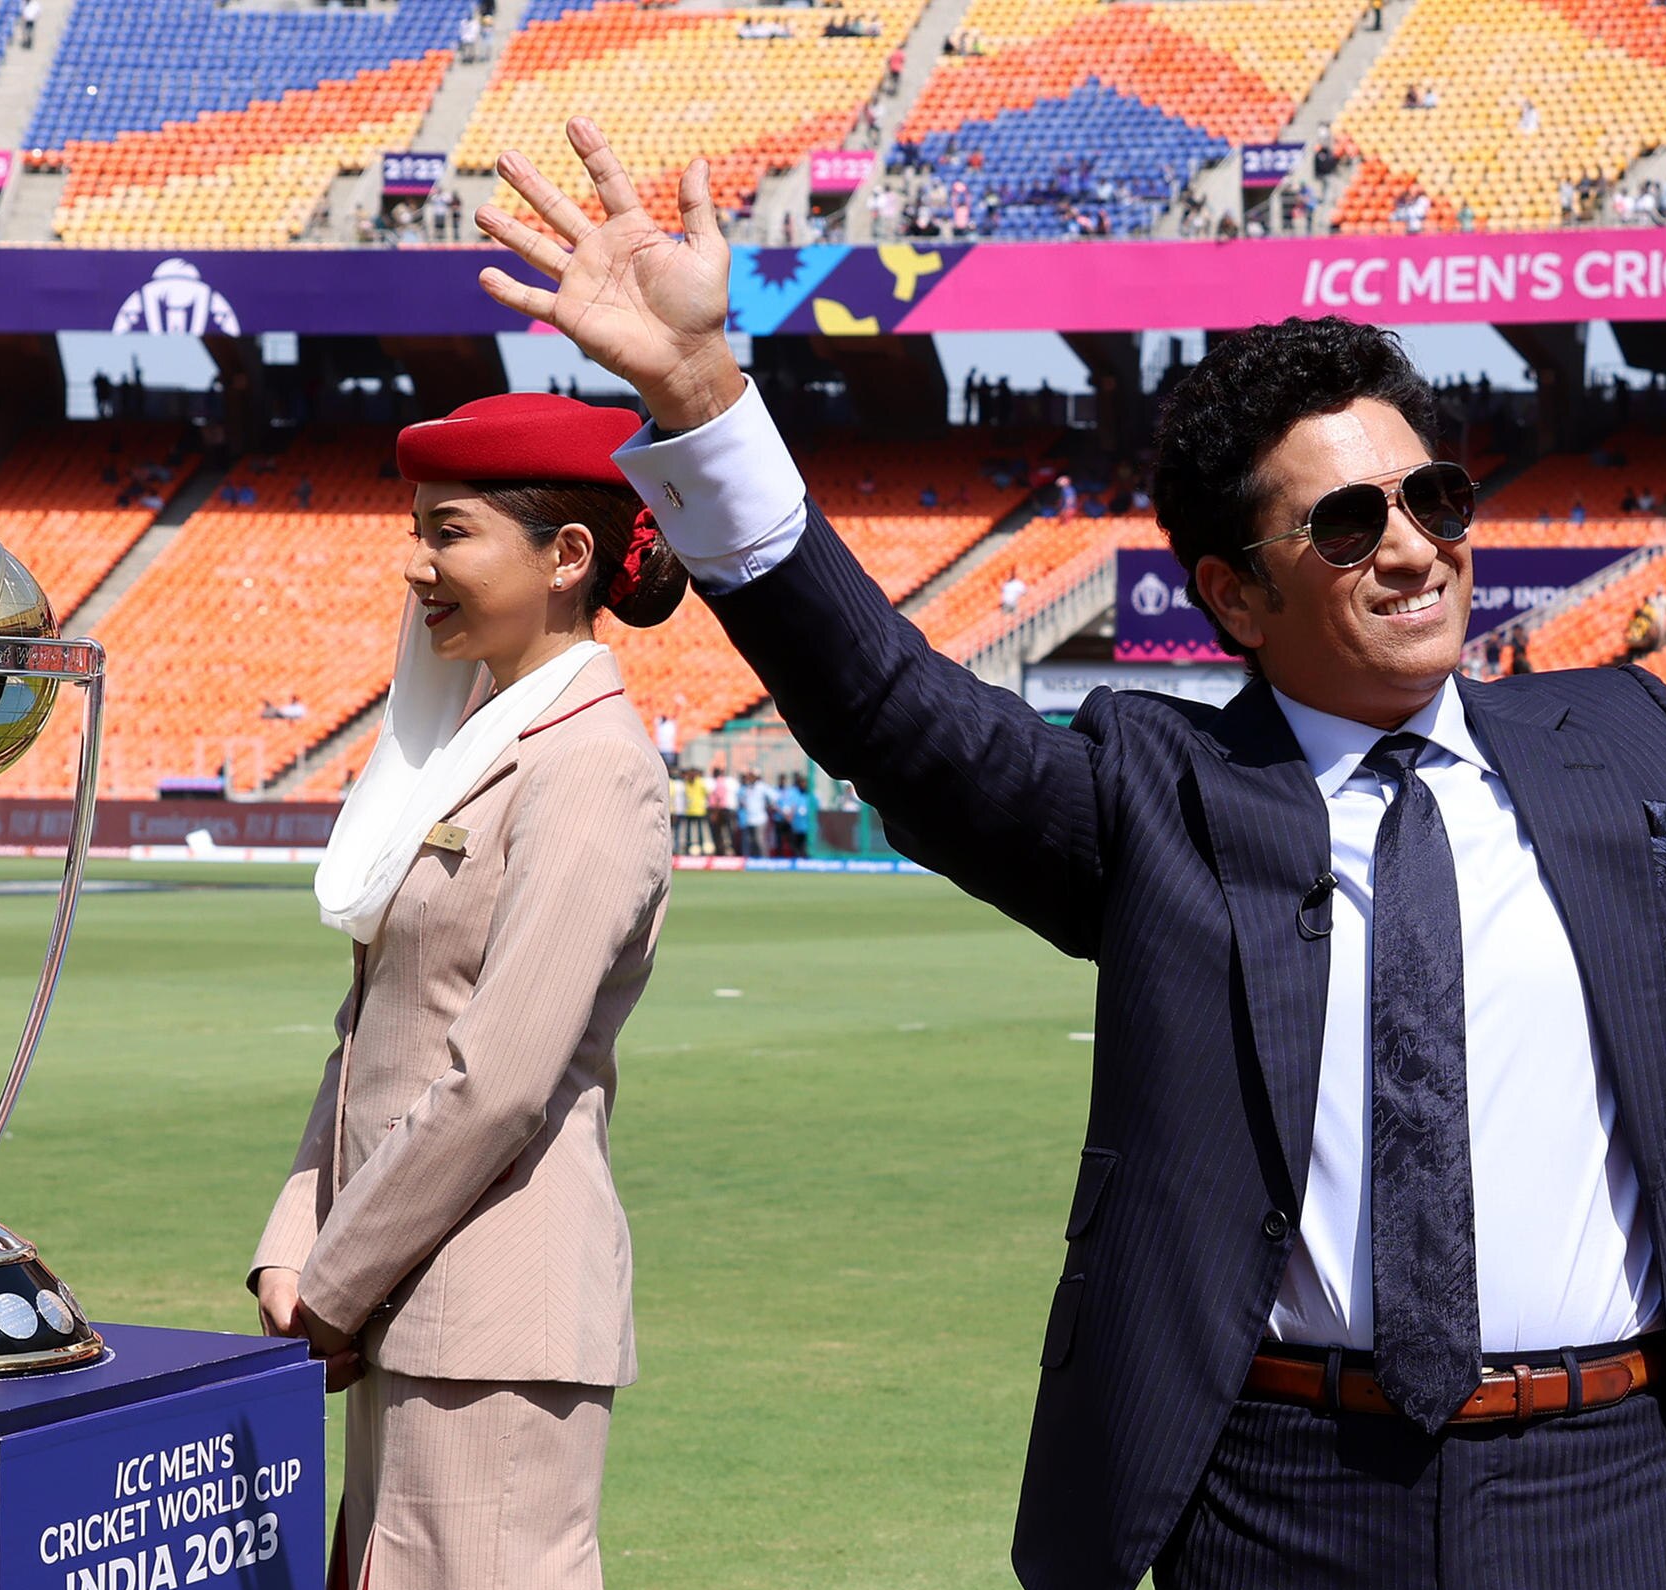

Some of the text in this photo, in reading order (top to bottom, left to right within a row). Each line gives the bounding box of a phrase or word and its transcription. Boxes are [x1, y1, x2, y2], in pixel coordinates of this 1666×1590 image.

[1302, 257, 1389, 306] ICC
[1397, 251, 1562, 305] MEN'S
[114, 1433, 234, 1499] ICC MEN'S
[39, 1458, 301, 1565] CRICKET WORLD CUP
[185, 1512, 278, 1585] 2023
